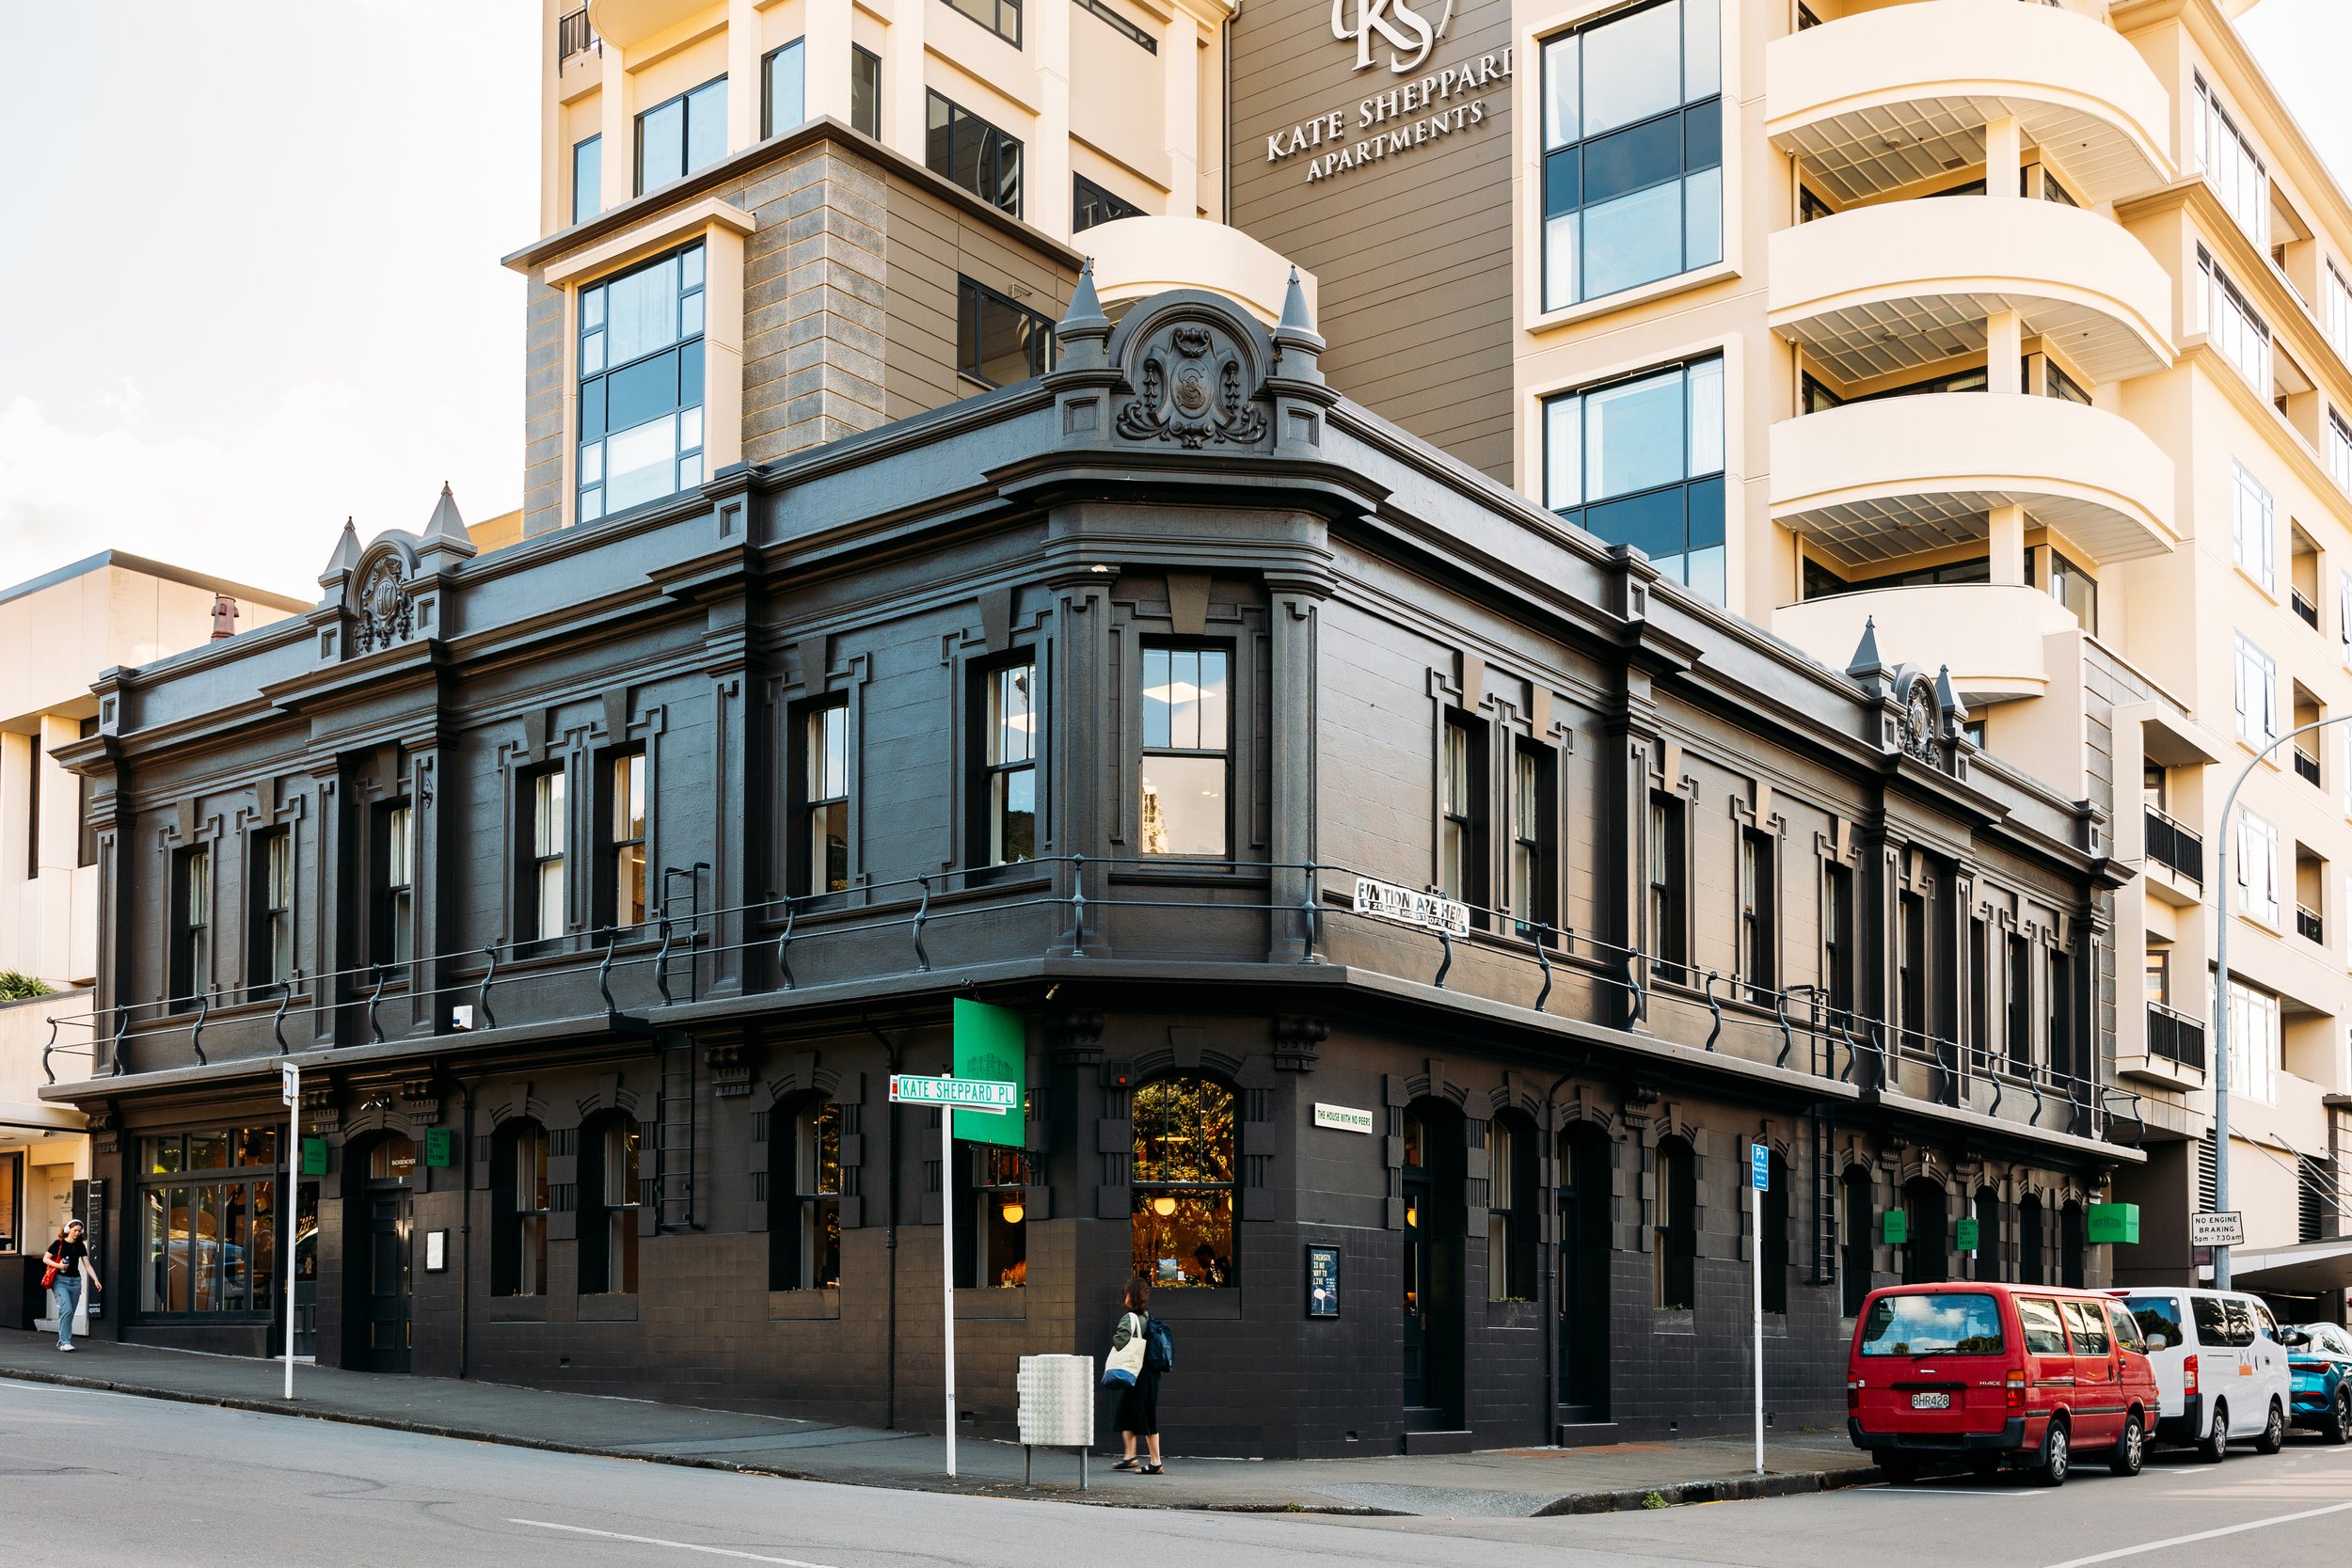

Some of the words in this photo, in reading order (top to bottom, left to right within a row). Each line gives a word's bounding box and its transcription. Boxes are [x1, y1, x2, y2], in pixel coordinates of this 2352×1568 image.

[1266, 110, 1344, 162] KATE
[1306, 100, 1484, 182] APARTMENTS
[903, 1080, 930, 1098] KATE
[936, 1082, 993, 1101] SHEPPARD
[998, 1086, 1011, 1102] PL
[1327, 1111, 1340, 1121] HOUSE
[1359, 1117, 1371, 1126] PEERS
[1913, 1395, 1948, 1406] BHR428
